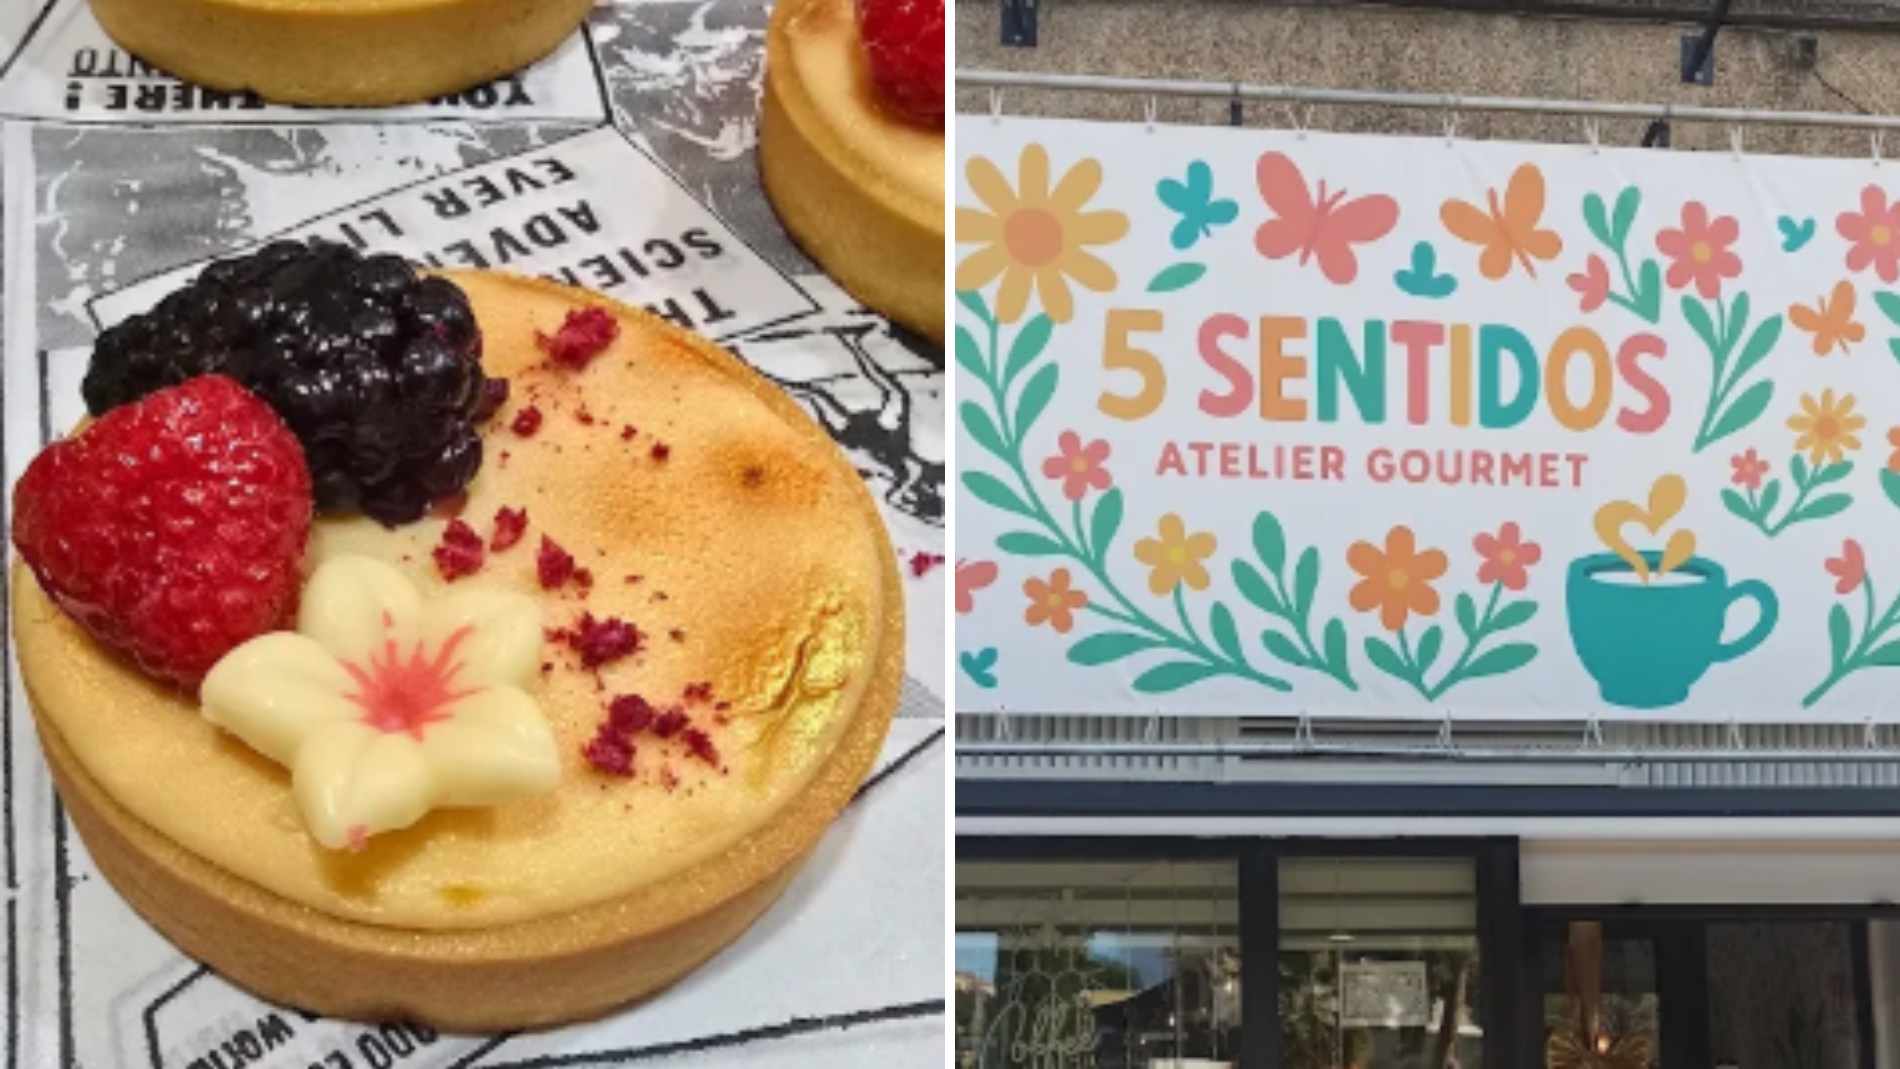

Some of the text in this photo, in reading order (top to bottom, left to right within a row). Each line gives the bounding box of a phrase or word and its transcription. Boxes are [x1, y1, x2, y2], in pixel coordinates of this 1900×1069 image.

[422, 158, 576, 219] EVER
[427, 199, 602, 270] ADVE
[549, 227, 724, 289] SCIE
[1097, 308, 1672, 435] 5 SENTIDOS
[1155, 441, 1590, 489] ATELIER GOURMET
